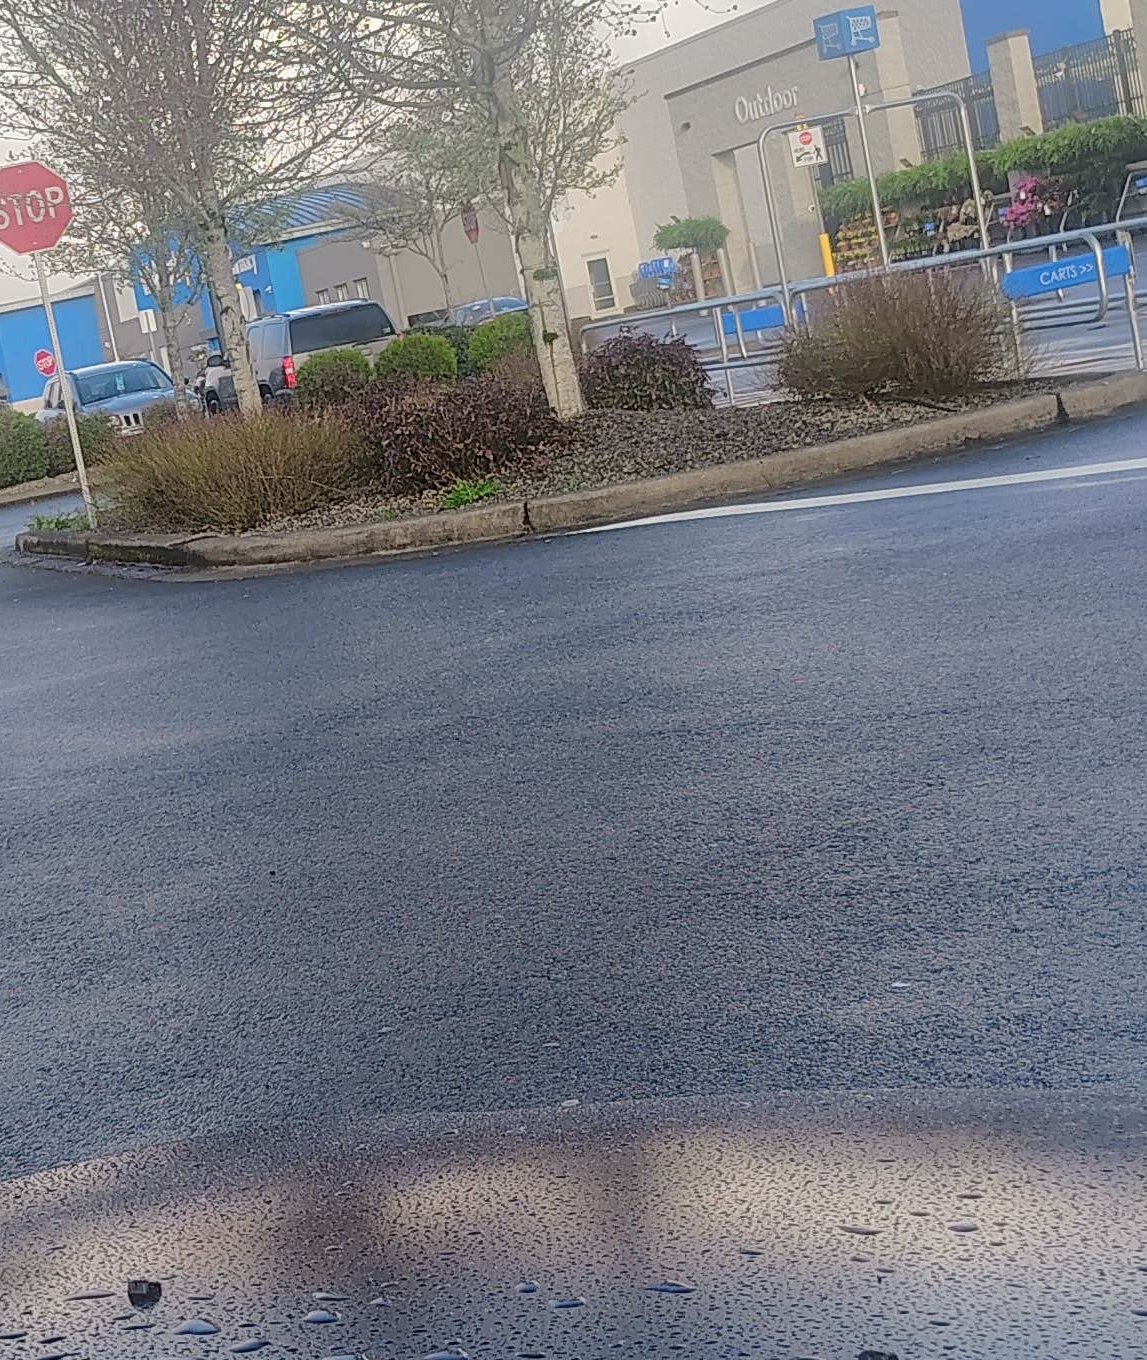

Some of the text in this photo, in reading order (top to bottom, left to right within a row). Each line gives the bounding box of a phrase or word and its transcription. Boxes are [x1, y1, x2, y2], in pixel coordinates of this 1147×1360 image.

[735, 85, 798, 123] Outdoor
[1039, 265, 1078, 285] CARTS
[36, 355, 54, 371] STOP
